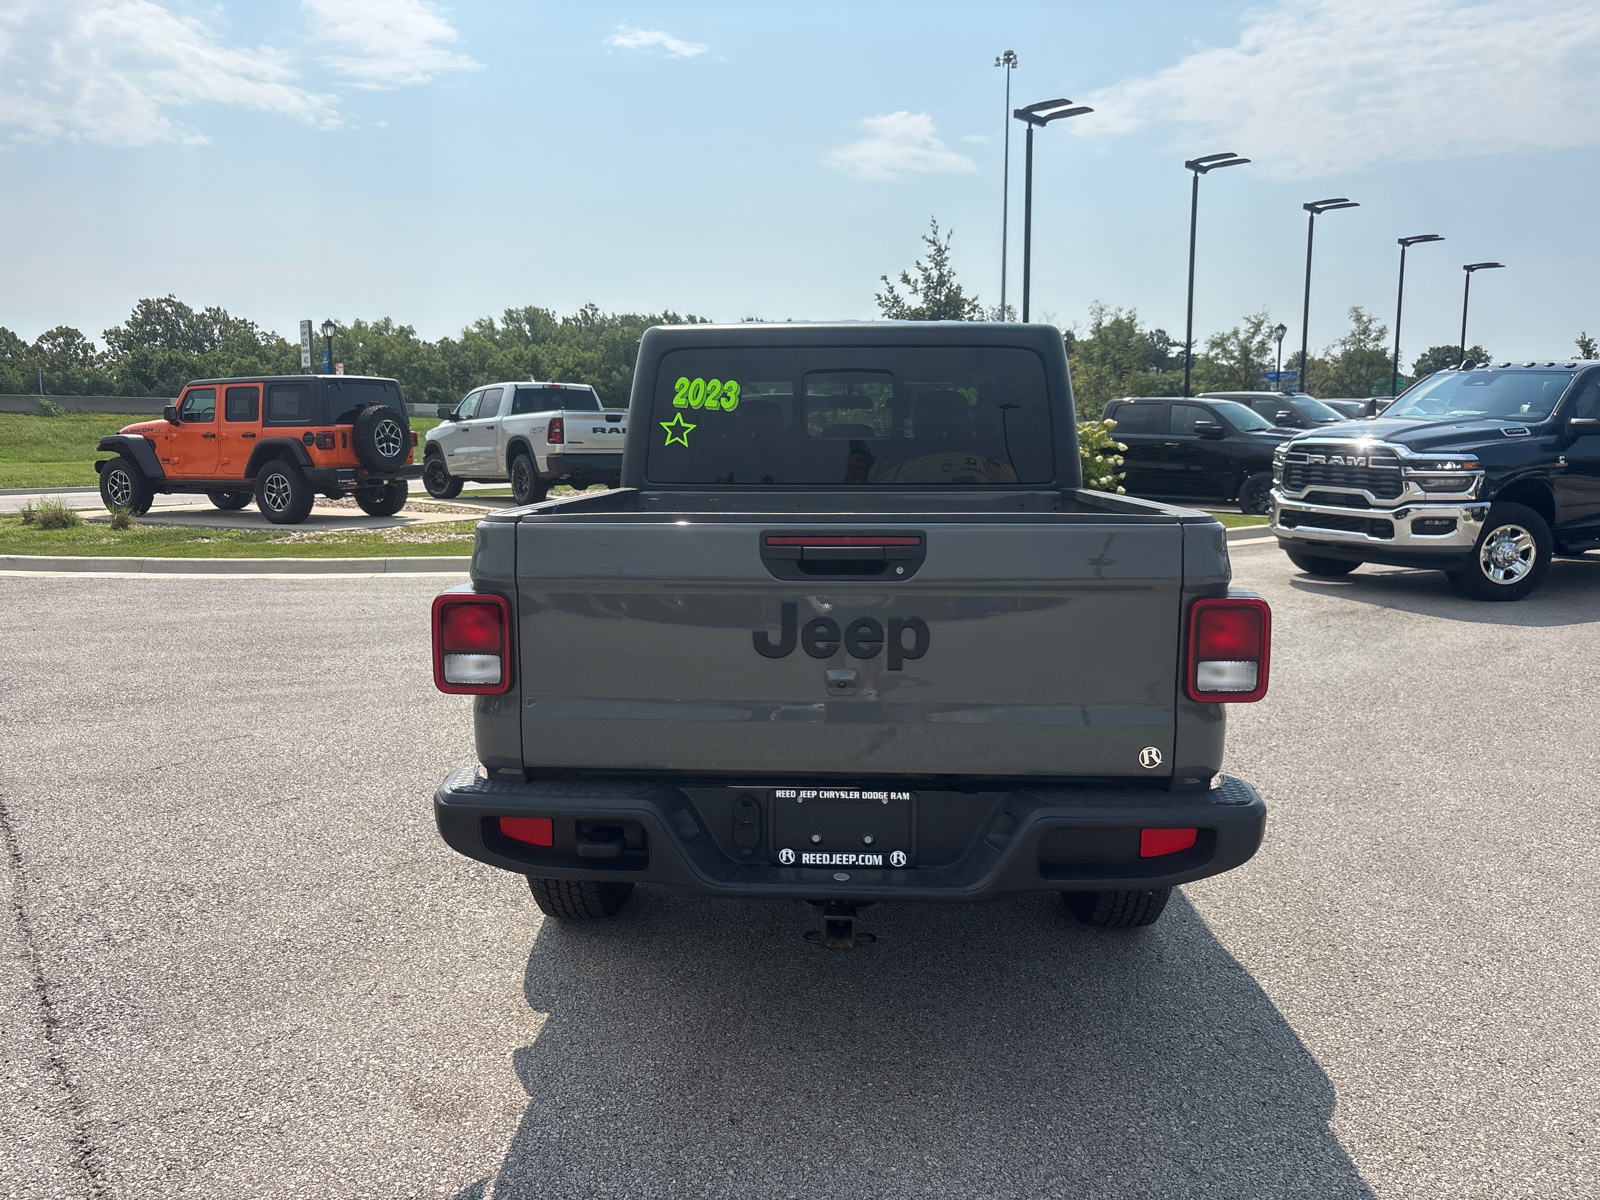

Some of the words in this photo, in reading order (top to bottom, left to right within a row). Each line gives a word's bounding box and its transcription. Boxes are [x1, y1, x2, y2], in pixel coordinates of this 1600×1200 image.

[673, 377, 740, 412] 2023
[1309, 454, 1366, 466] RAM
[752, 601, 930, 671] Jeep
[776, 790, 796, 798] REED
[798, 790, 817, 799] JEEP
[819, 791, 860, 799] CHRYSLER
[862, 792, 888, 800] DODGE
[890, 792, 910, 800] RAM
[802, 853, 882, 866] REEDJEEP.COM
